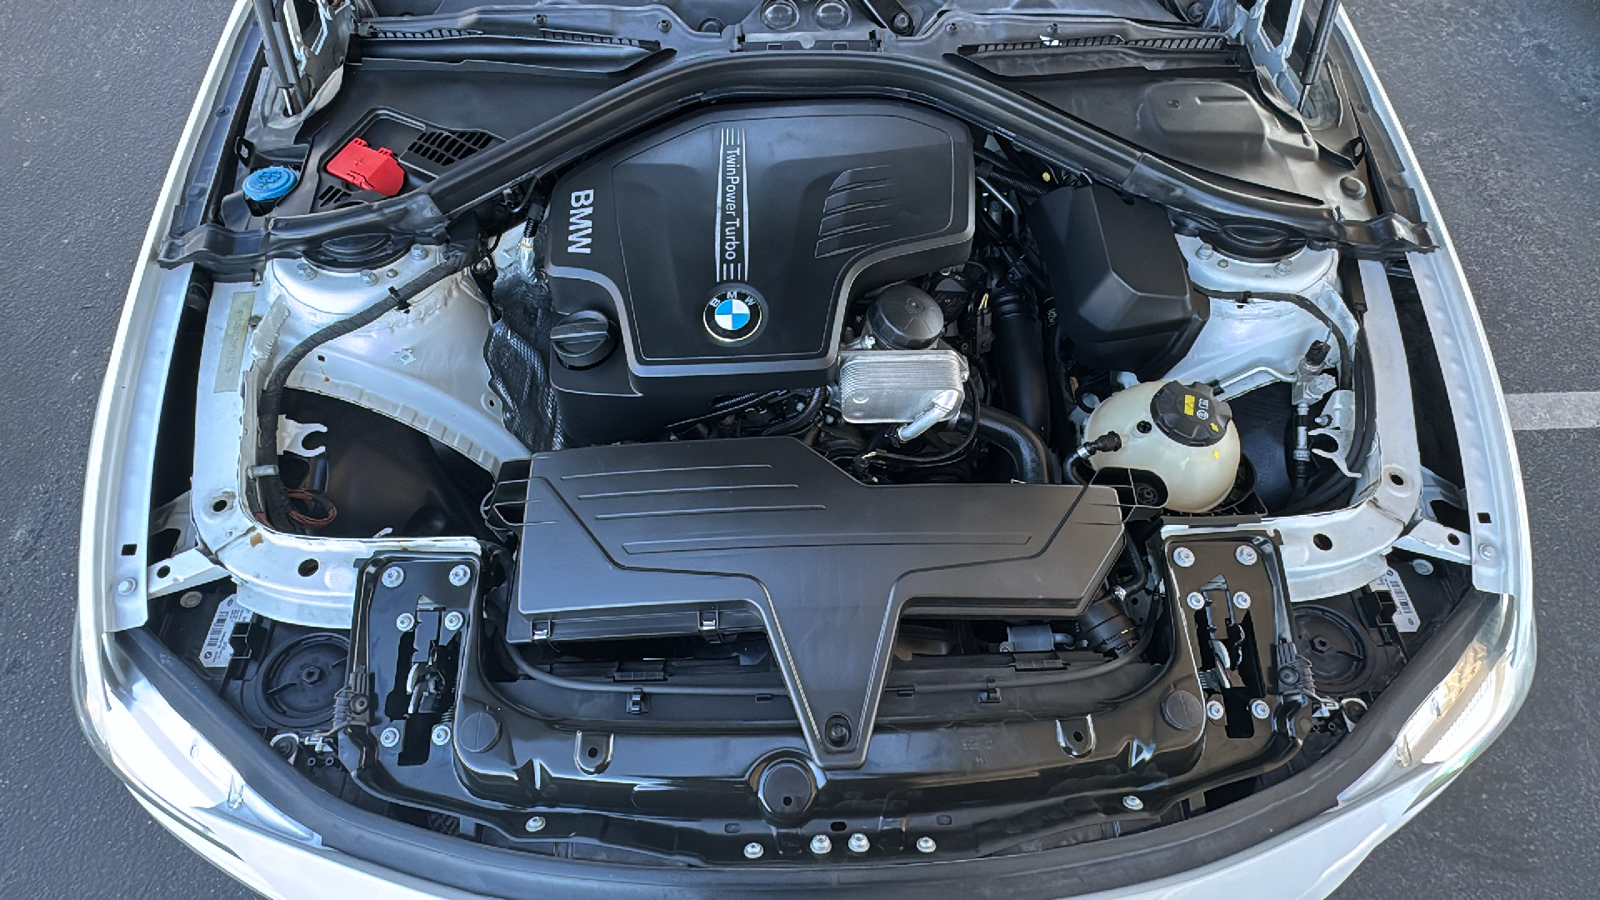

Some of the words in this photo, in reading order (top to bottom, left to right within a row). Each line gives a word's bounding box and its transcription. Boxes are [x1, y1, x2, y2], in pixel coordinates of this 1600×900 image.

[725, 147, 741, 217] TwinPower
[567, 188, 594, 254] BMW
[724, 217, 741, 260] Turbo
[709, 291, 756, 307] BMW
